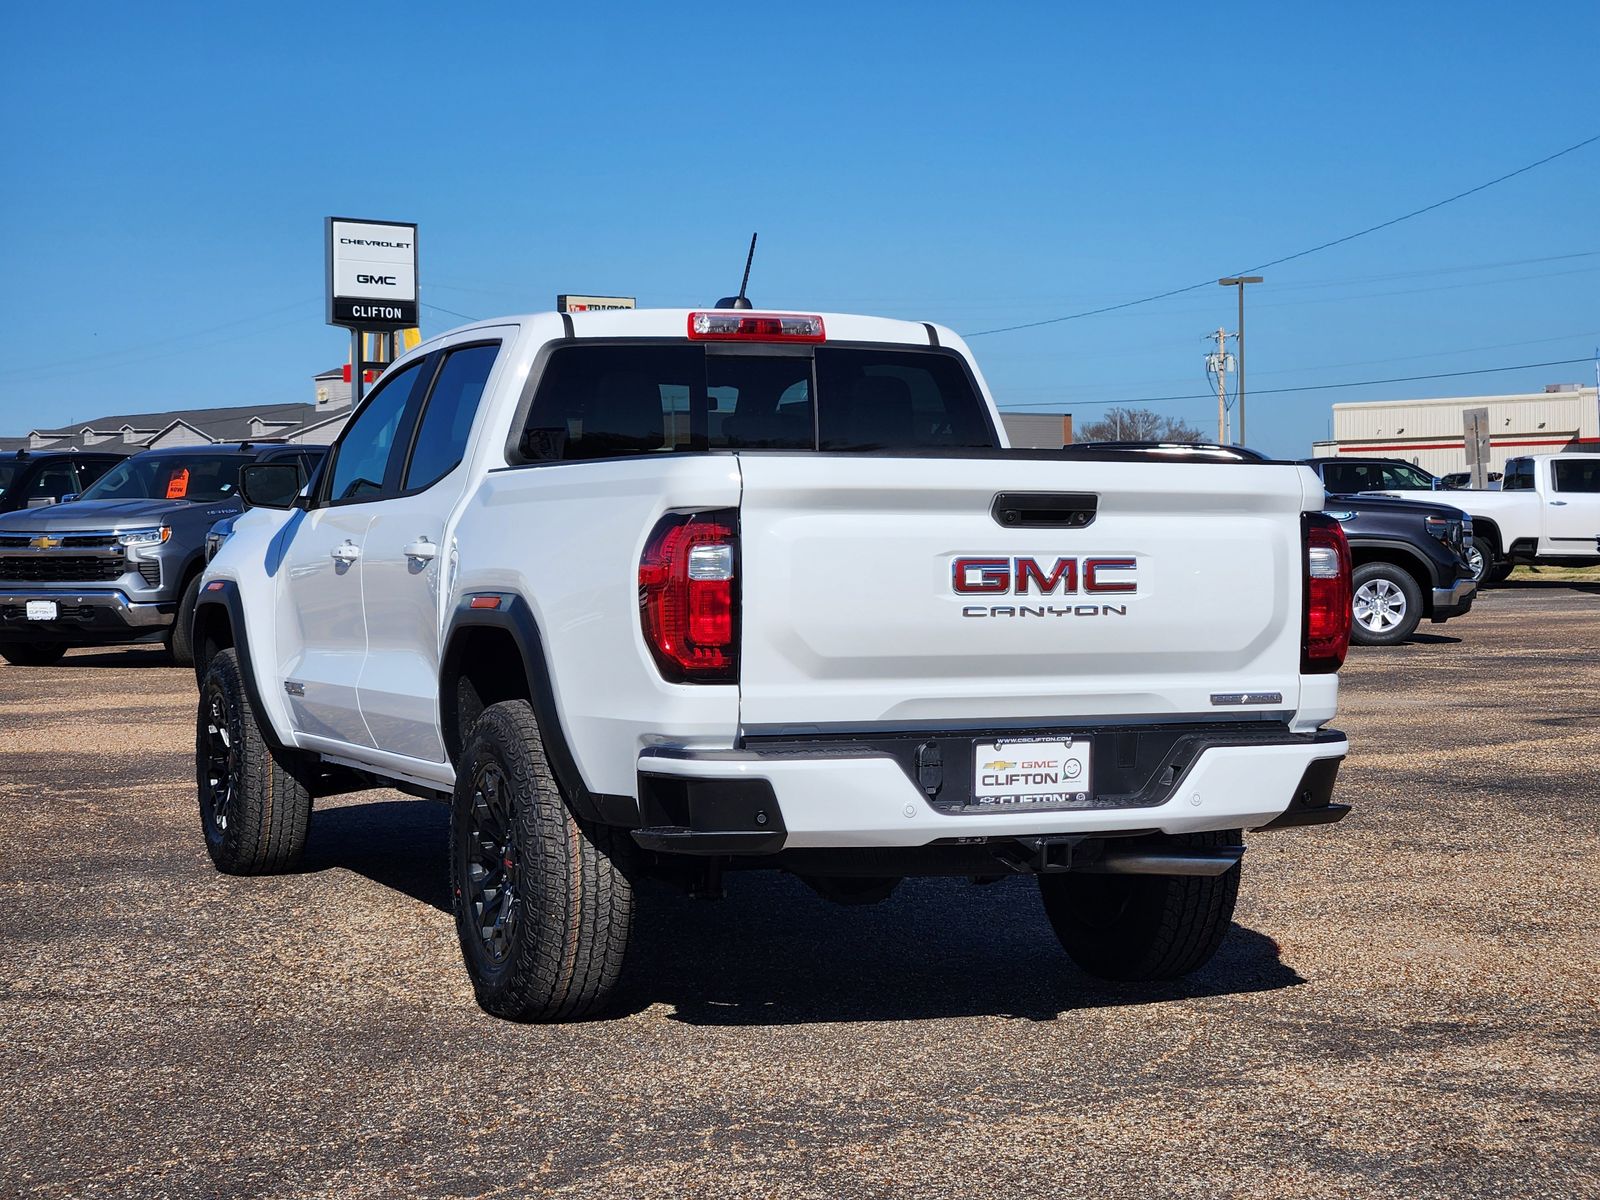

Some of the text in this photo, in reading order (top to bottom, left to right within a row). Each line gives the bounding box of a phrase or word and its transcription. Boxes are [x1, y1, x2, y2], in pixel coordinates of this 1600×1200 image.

[340, 238, 411, 249] CHEVROLET
[356, 274, 397, 286] GMC
[352, 305, 402, 319] CLIFTON
[952, 556, 1137, 596] GMC
[962, 604, 1127, 618] CANYON
[1021, 760, 1059, 769] GMC
[982, 772, 1059, 786] CLIFTON
